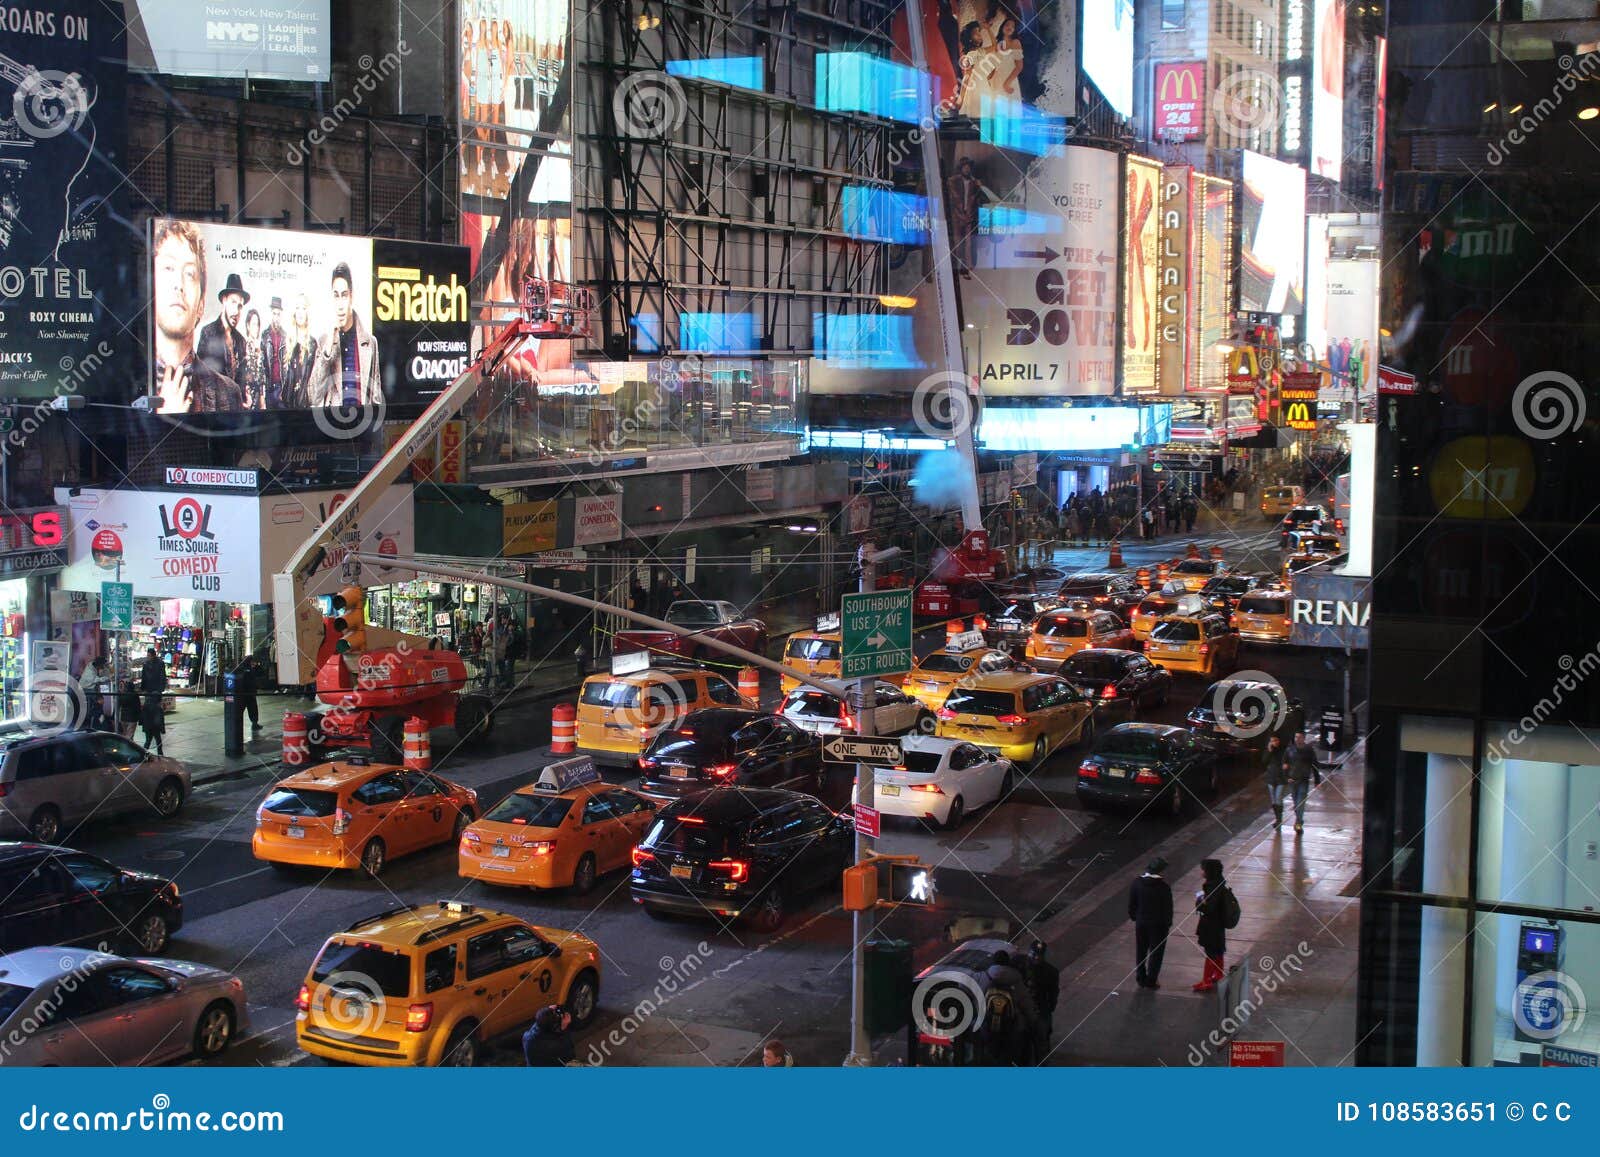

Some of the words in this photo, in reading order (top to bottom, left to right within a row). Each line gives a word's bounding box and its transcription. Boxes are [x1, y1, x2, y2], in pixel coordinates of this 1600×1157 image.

[260, 8, 283, 19] New
[0, 7, 56, 36] ROARS
[63, 15, 88, 41] ON
[206, 21, 259, 42] NYC
[268, 33, 290, 42] FOR
[1162, 103, 1196, 111] OPEN
[1166, 112, 1191, 125] 24
[1072, 183, 1091, 194] SET
[1053, 195, 1103, 210] YOURSELF
[1068, 210, 1093, 223] FREE
[240, 246, 275, 265] cheeky
[1063, 247, 1094, 264] THE
[1163, 181, 1181, 342] PALACE
[0, 266, 93, 299] OTEL
[1035, 268, 1107, 307] GET
[376, 273, 467, 323] snatch
[30, 312, 56, 323] ROXY
[59, 312, 94, 323] CINEMA
[37, 330, 55, 340] Now
[56, 330, 90, 341] Showing
[417, 341, 433, 352] NOW
[433, 341, 467, 352] STREAMING
[0, 353, 33, 363] JACK'S
[1, 371, 22, 380] Brew
[23, 371, 48, 382] Coffee
[411, 356, 468, 380] CRACKLE
[982, 363, 1043, 381] APRIL
[1049, 363, 1059, 381] 7
[168, 467, 189, 484] LOL
[159, 497, 215, 540] LOL
[158, 536, 184, 552] TIMES
[185, 538, 219, 555] SQUARE
[163, 556, 219, 576] COMEDY
[192, 575, 221, 592] CLUB
[846, 595, 909, 613] SOUTHBOUND
[851, 616, 869, 631] USE
[885, 613, 903, 627] AVE
[848, 657, 871, 672] BEST
[876, 652, 907, 668] ROUTE
[833, 743, 857, 755] ONE
[870, 745, 895, 757] WAY
[1232, 1044, 1242, 1052] NO
[1244, 1044, 1277, 1052] STANDING
[1232, 1053, 1261, 1061] Anytime
